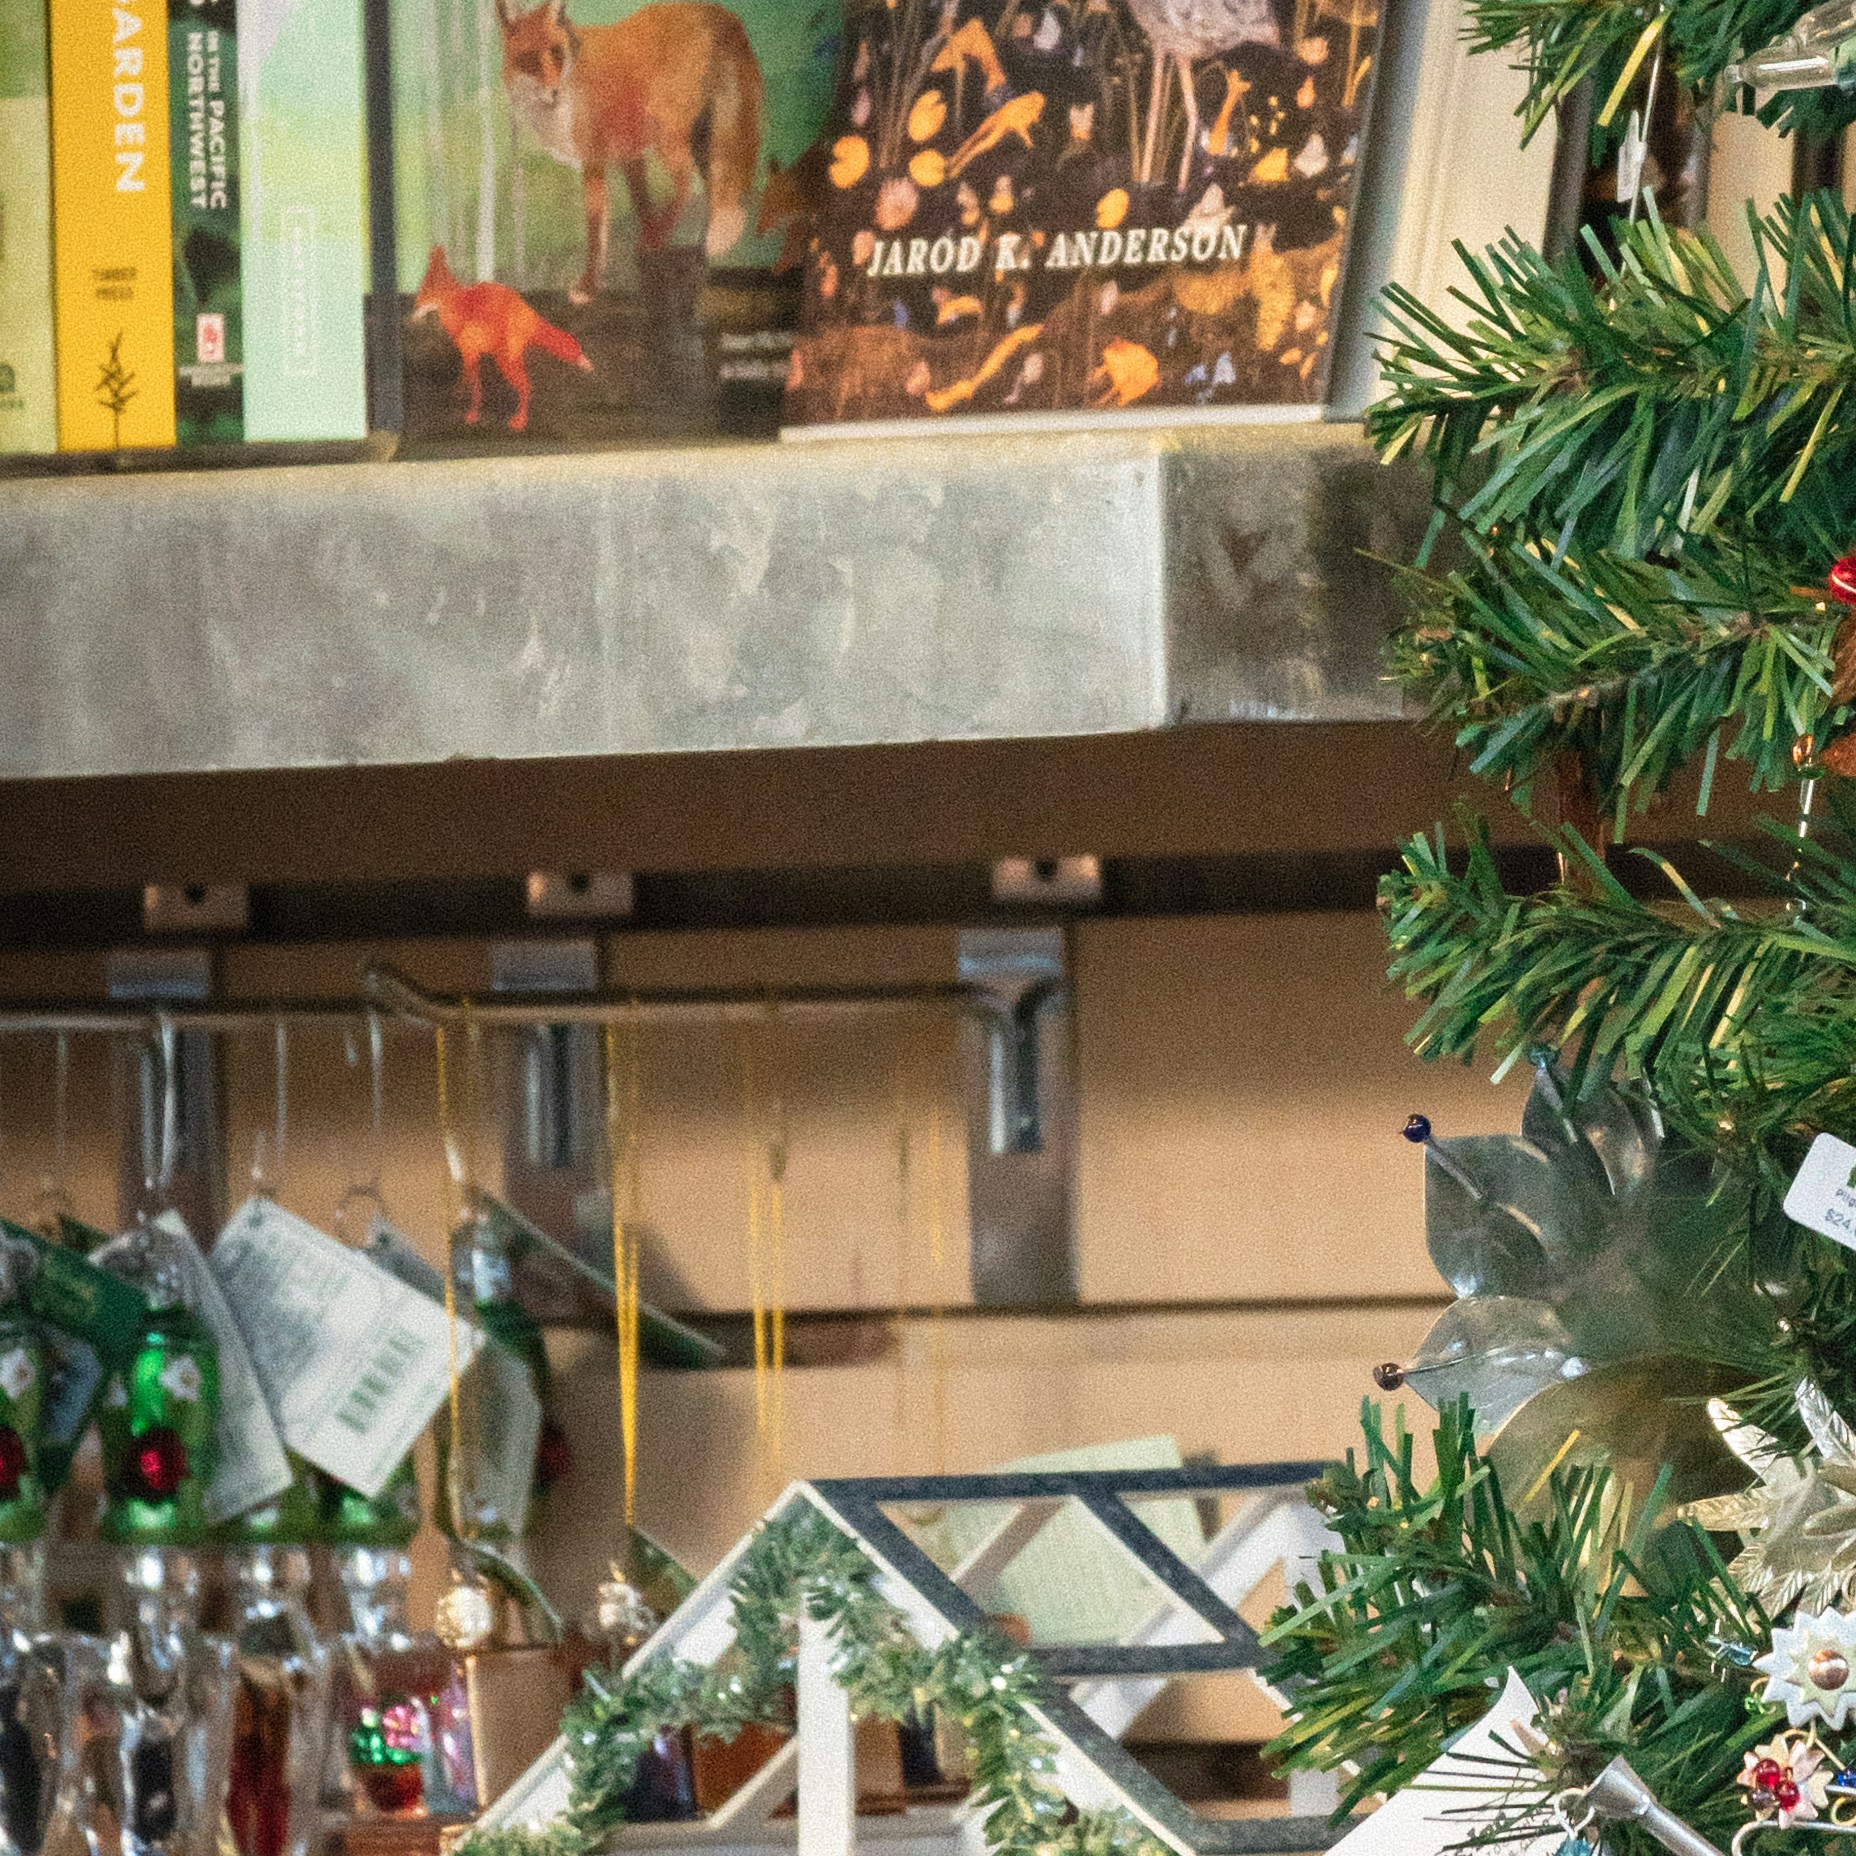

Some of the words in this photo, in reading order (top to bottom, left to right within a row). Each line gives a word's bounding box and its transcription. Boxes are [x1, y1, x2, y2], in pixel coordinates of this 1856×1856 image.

[208, 30, 220, 58] IN
[209, 62, 221, 96] THE
[188, 31, 208, 211] NORTHWEST
[209, 100, 228, 211] PACIFIC
[867, 234, 983, 278] JAROD
[997, 233, 1031, 271] K.
[1046, 223, 1249, 270] ANDERSON
